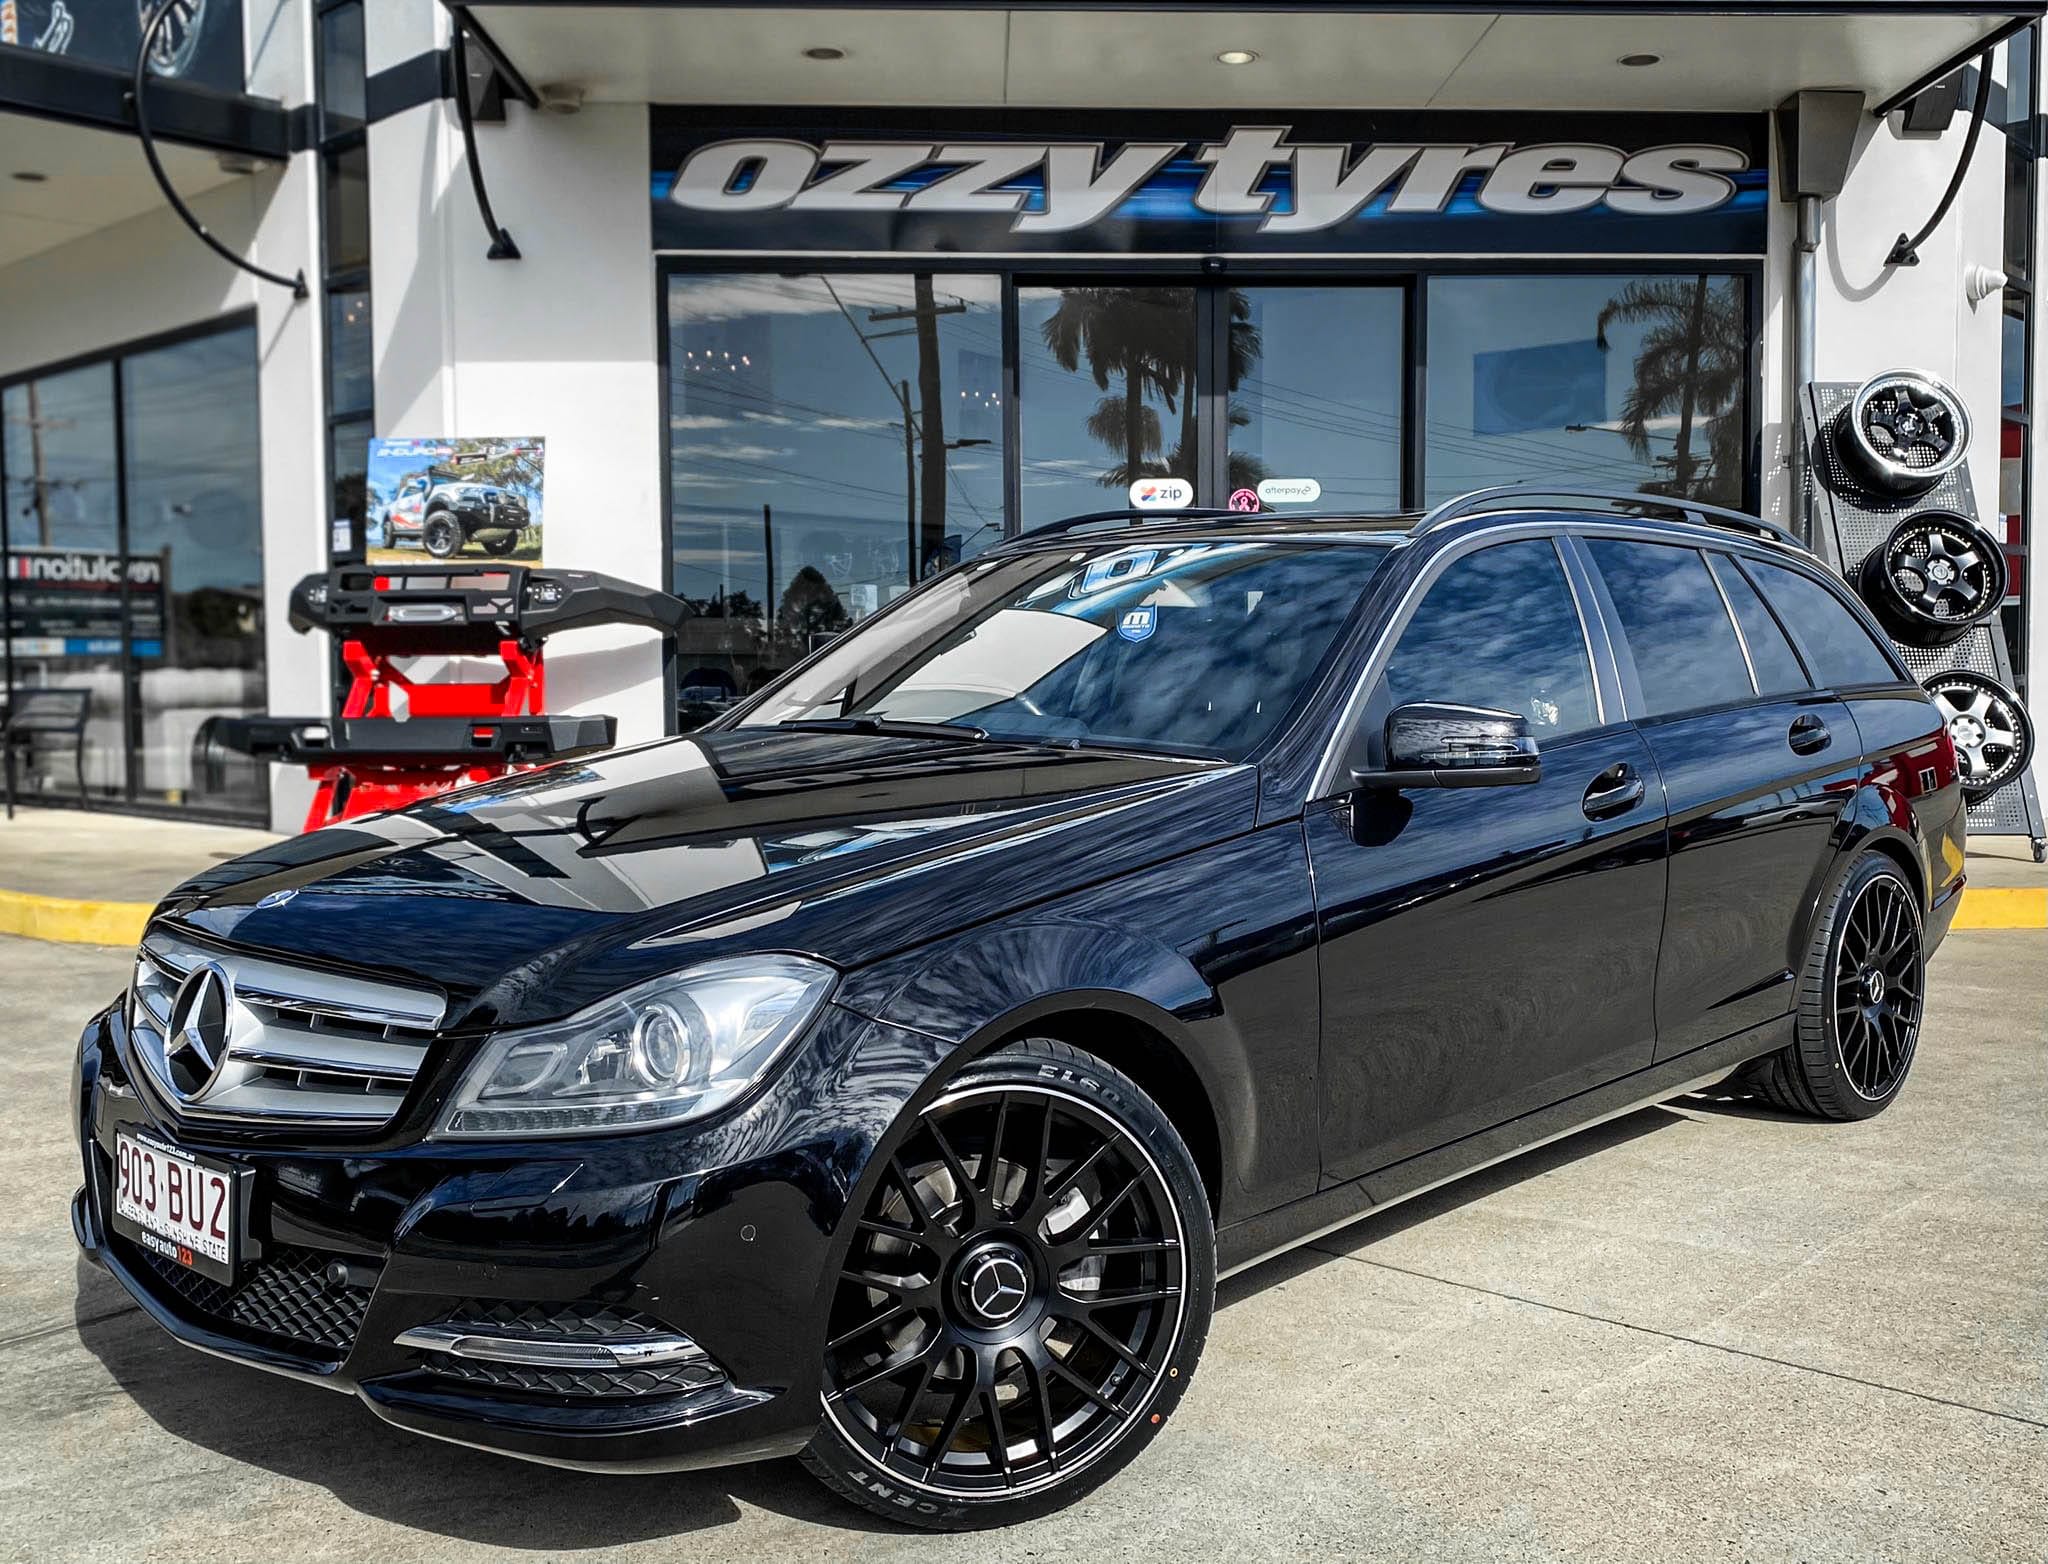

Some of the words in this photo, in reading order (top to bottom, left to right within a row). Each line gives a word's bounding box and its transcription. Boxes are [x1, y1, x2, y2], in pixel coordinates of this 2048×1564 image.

[670, 138, 1187, 233] ozzy
[1195, 125, 1751, 233] tyres
[1160, 485, 1182, 499] zip
[1265, 486, 1301, 496] afterpay
[120, 1140, 156, 1213] 903
[203, 1239, 226, 1262] STATE
